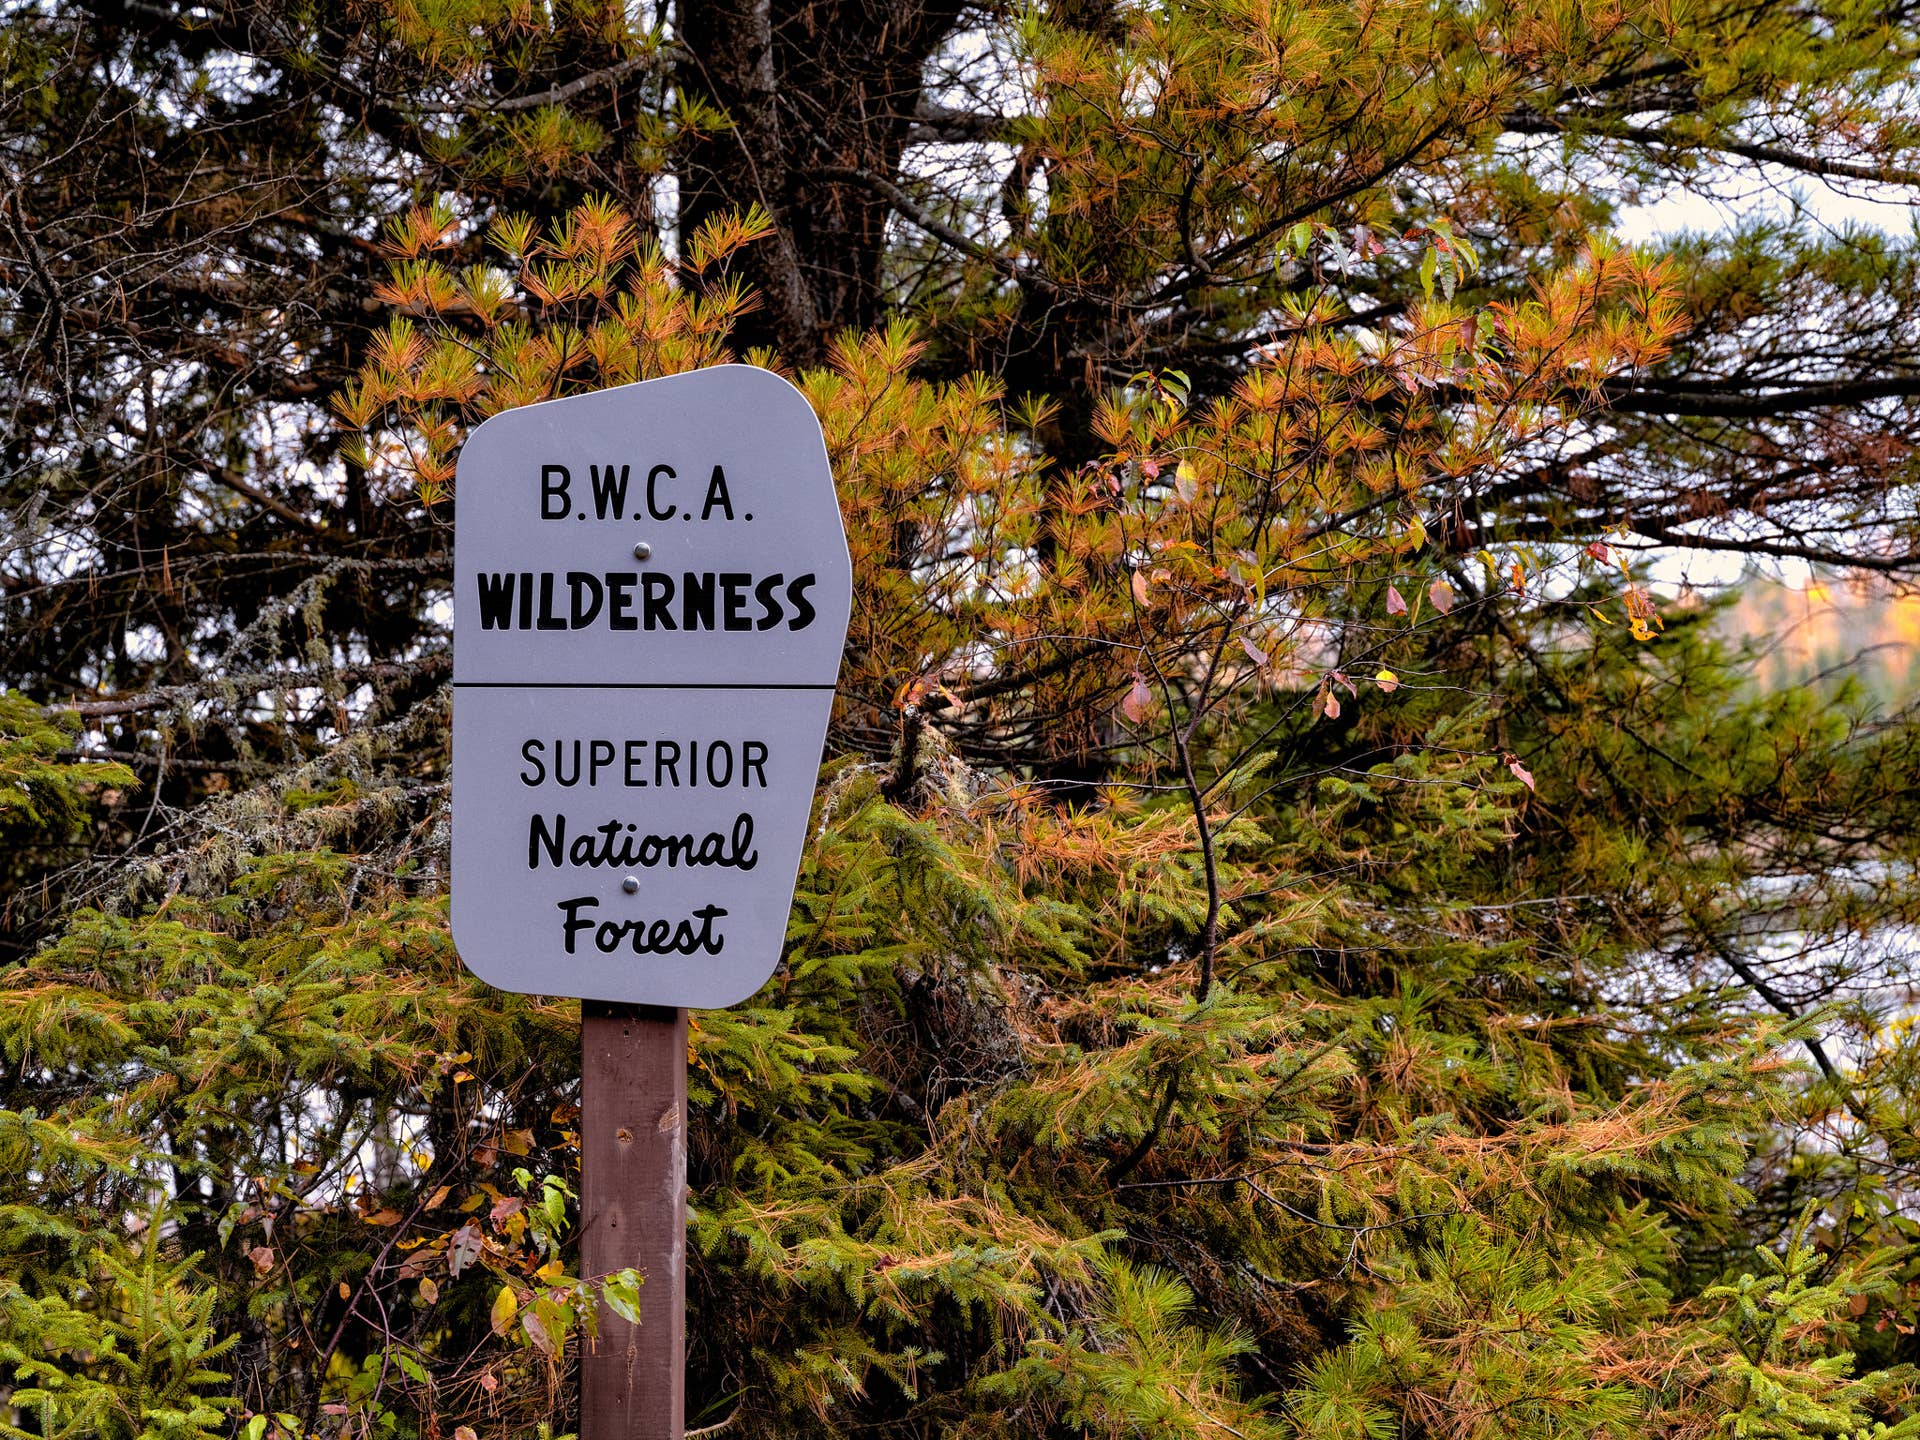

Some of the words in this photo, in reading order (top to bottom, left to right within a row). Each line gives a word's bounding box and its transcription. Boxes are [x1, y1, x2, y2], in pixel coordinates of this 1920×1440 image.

[540, 463, 754, 522] B.W.C.A.
[476, 571, 816, 632] WILDERNESS
[520, 738, 769, 789] SUPERIOR
[528, 812, 759, 871] National
[557, 892, 729, 956] Forest
